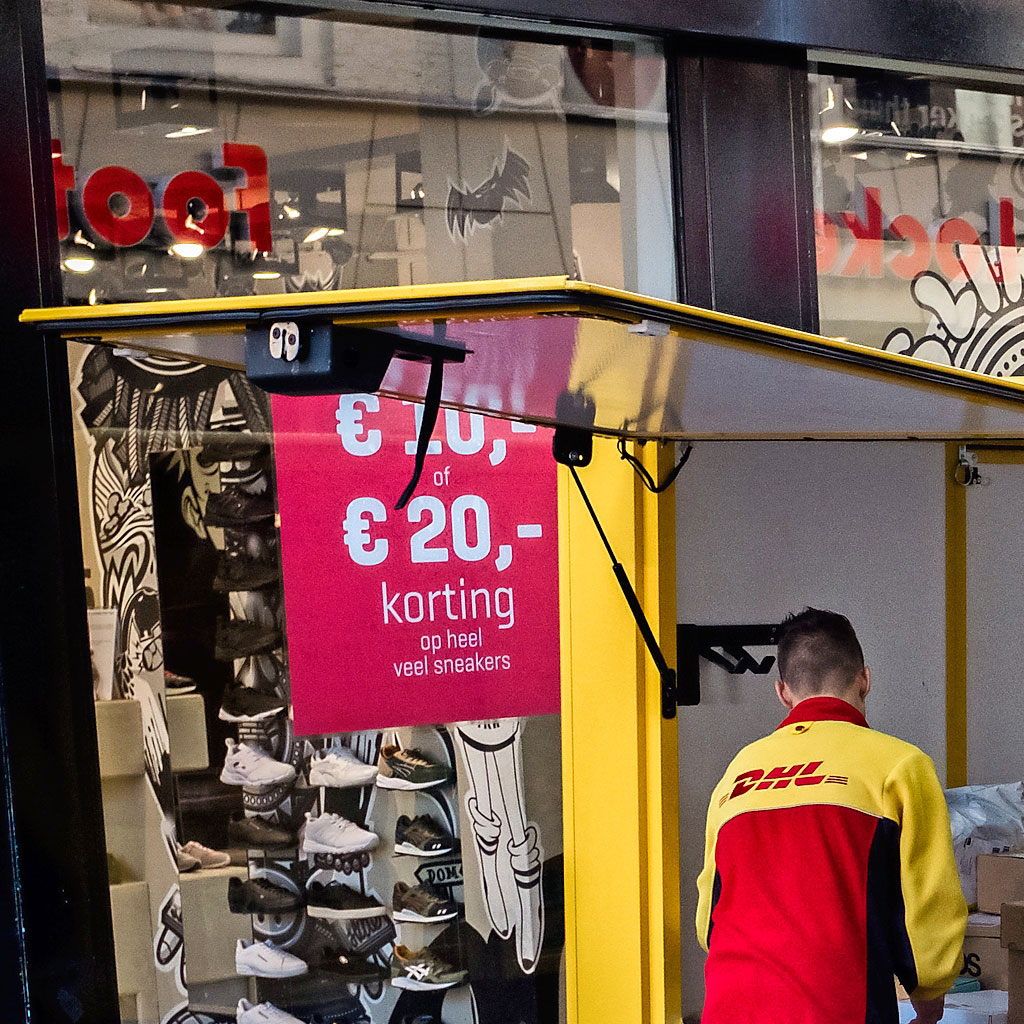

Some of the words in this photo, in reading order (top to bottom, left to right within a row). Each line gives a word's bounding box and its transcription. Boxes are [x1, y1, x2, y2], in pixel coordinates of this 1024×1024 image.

[336, 393, 382, 456] €
[434, 466, 450, 486] of
[343, 497, 388, 566] €
[407, 494, 542, 572] 20,-
[381, 577, 515, 630] korting
[420, 633, 442, 655] op
[446, 627, 482, 649] heel
[393, 655, 428, 677] veel
[434, 651, 511, 675] sneakers
[729, 760, 826, 800] DHL
